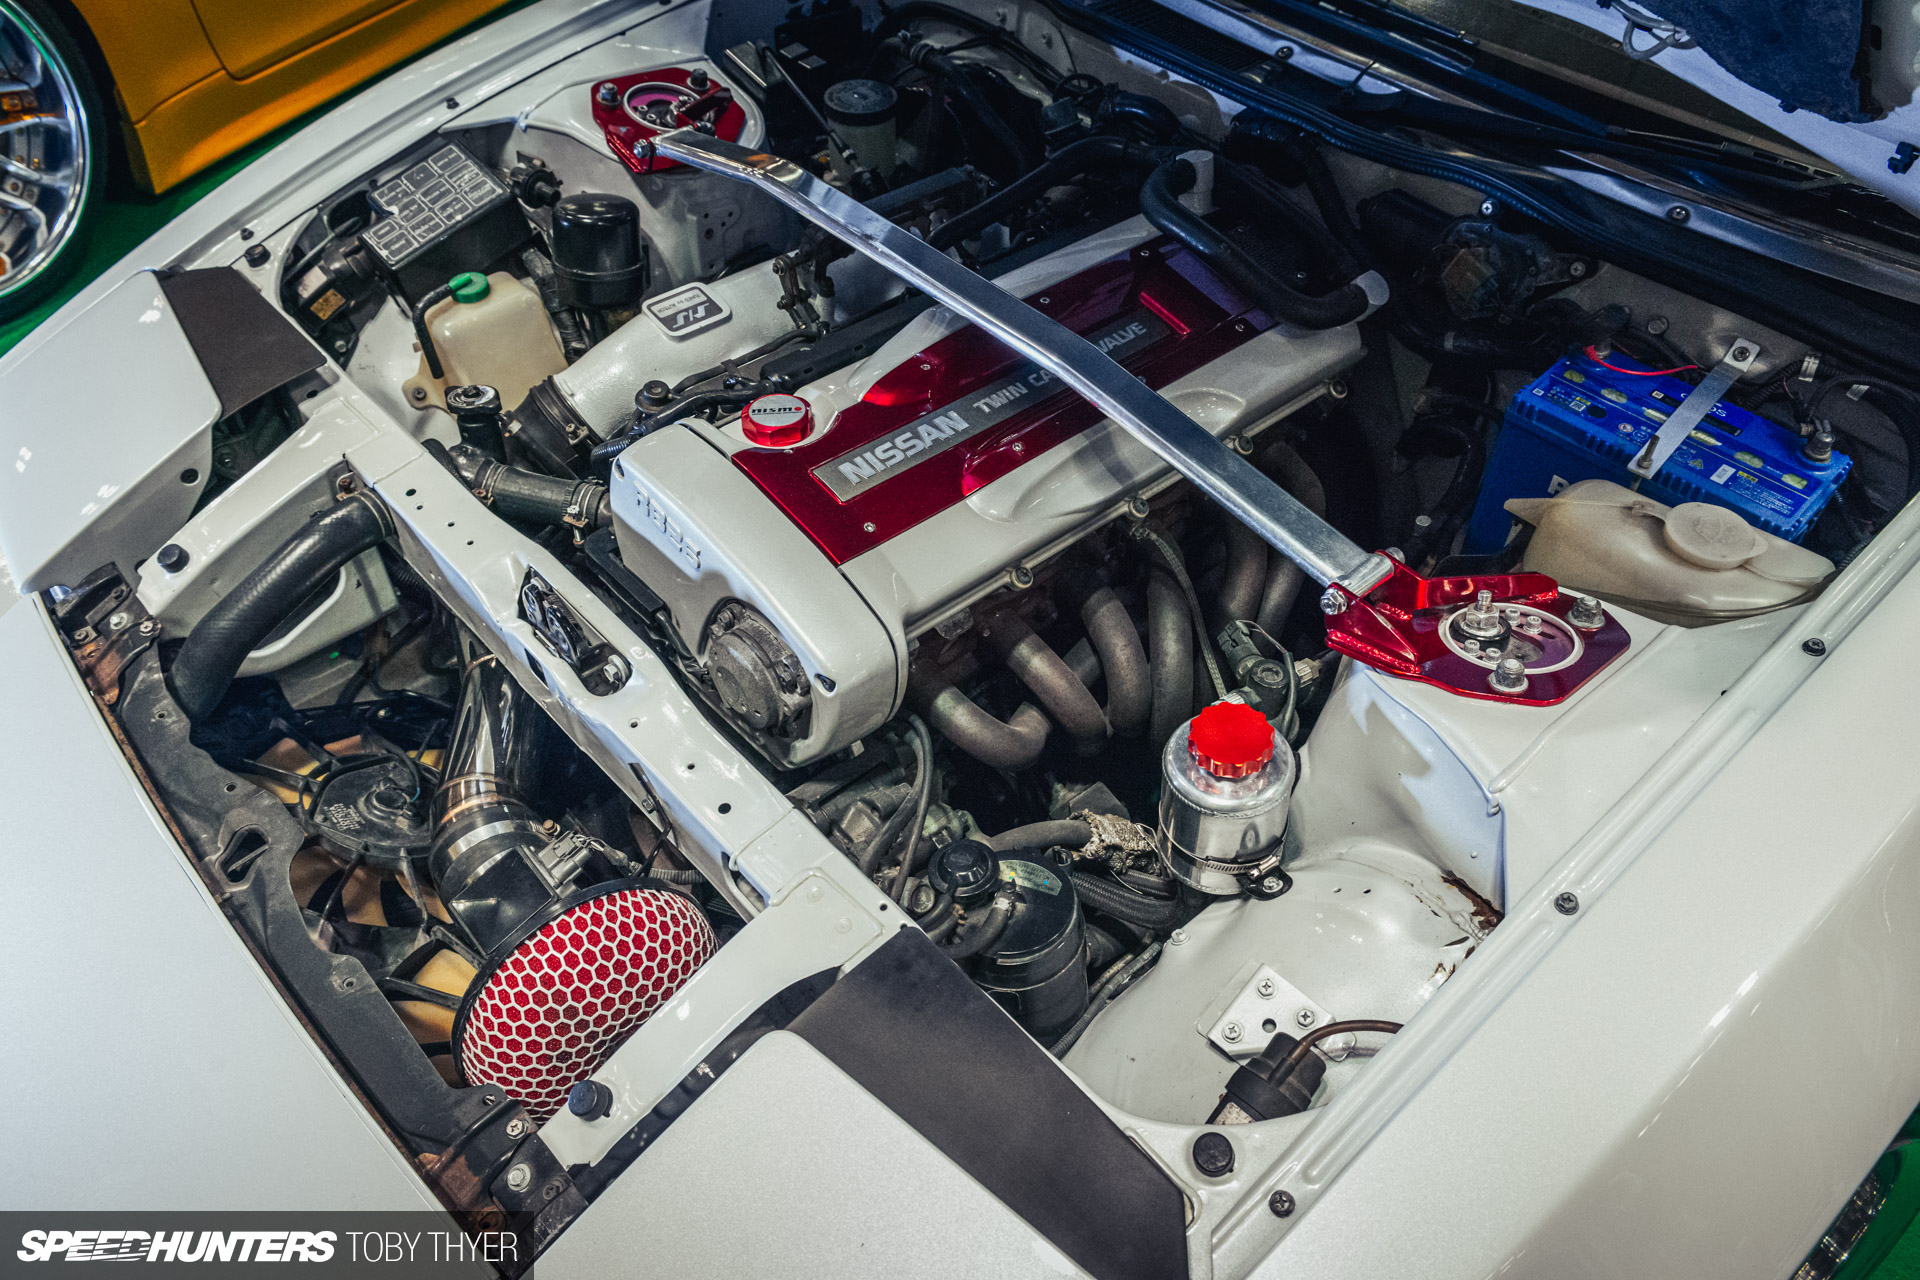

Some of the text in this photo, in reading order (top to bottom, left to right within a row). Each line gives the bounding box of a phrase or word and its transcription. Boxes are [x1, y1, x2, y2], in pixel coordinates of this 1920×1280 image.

[838, 410, 970, 486] NISSAN
[973, 381, 1029, 414] TWIN
[1027, 368, 1056, 388] CA
